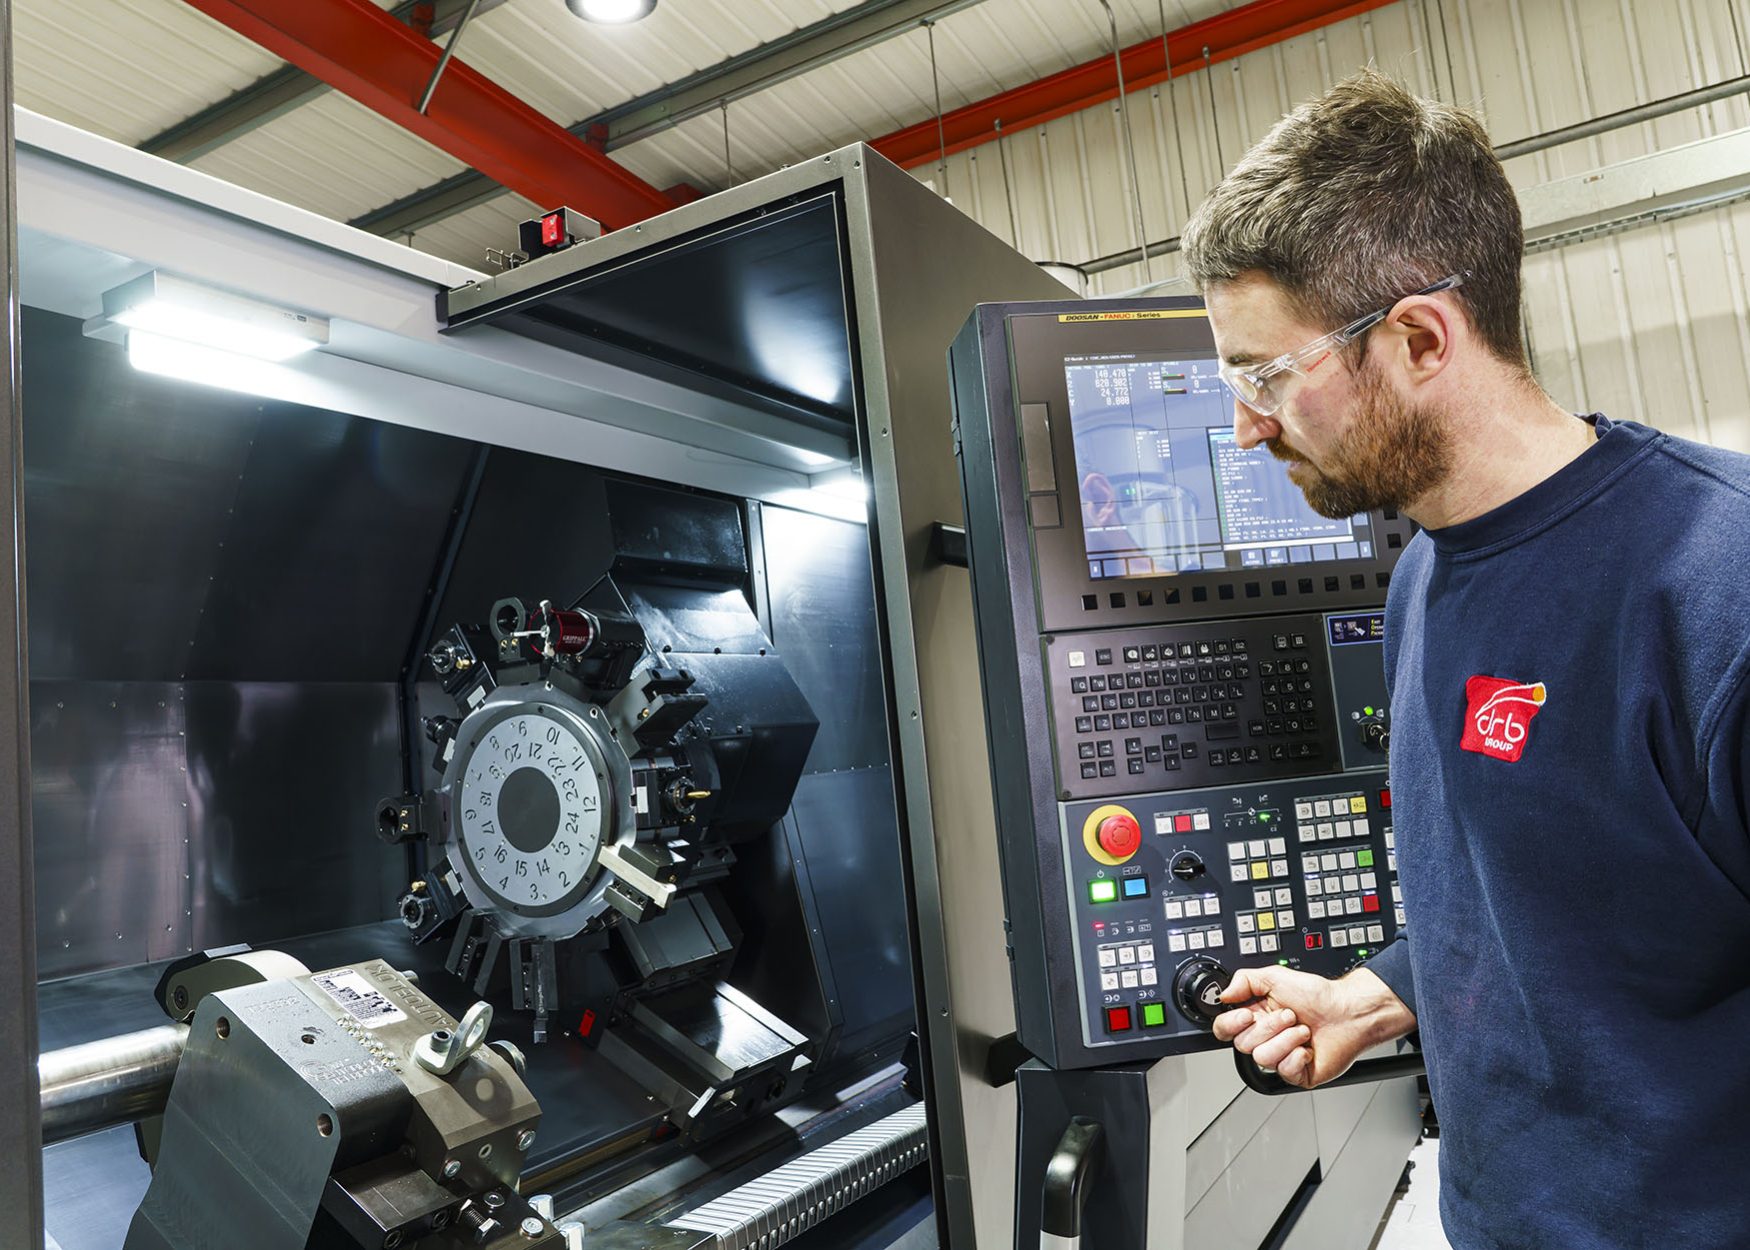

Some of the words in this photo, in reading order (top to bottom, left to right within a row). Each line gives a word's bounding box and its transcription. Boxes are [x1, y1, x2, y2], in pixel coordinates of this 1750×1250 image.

[489, 735, 501, 751] 8
[546, 726, 561, 746] 10
[504, 743, 522, 763] 20
[528, 742, 543, 760] 21
[480, 791, 492, 808] 18
[562, 778, 580, 803] 23
[583, 796, 597, 814] 12
[481, 820, 495, 836] 17
[565, 812, 580, 834] 24
[475, 847, 487, 861] 5
[493, 845, 508, 864] 16
[515, 859, 528, 878] 15
[536, 858, 551, 877] 14
[498, 876, 509, 890] 4
[558, 871, 571, 888] 2
[529, 883, 539, 900] 3
